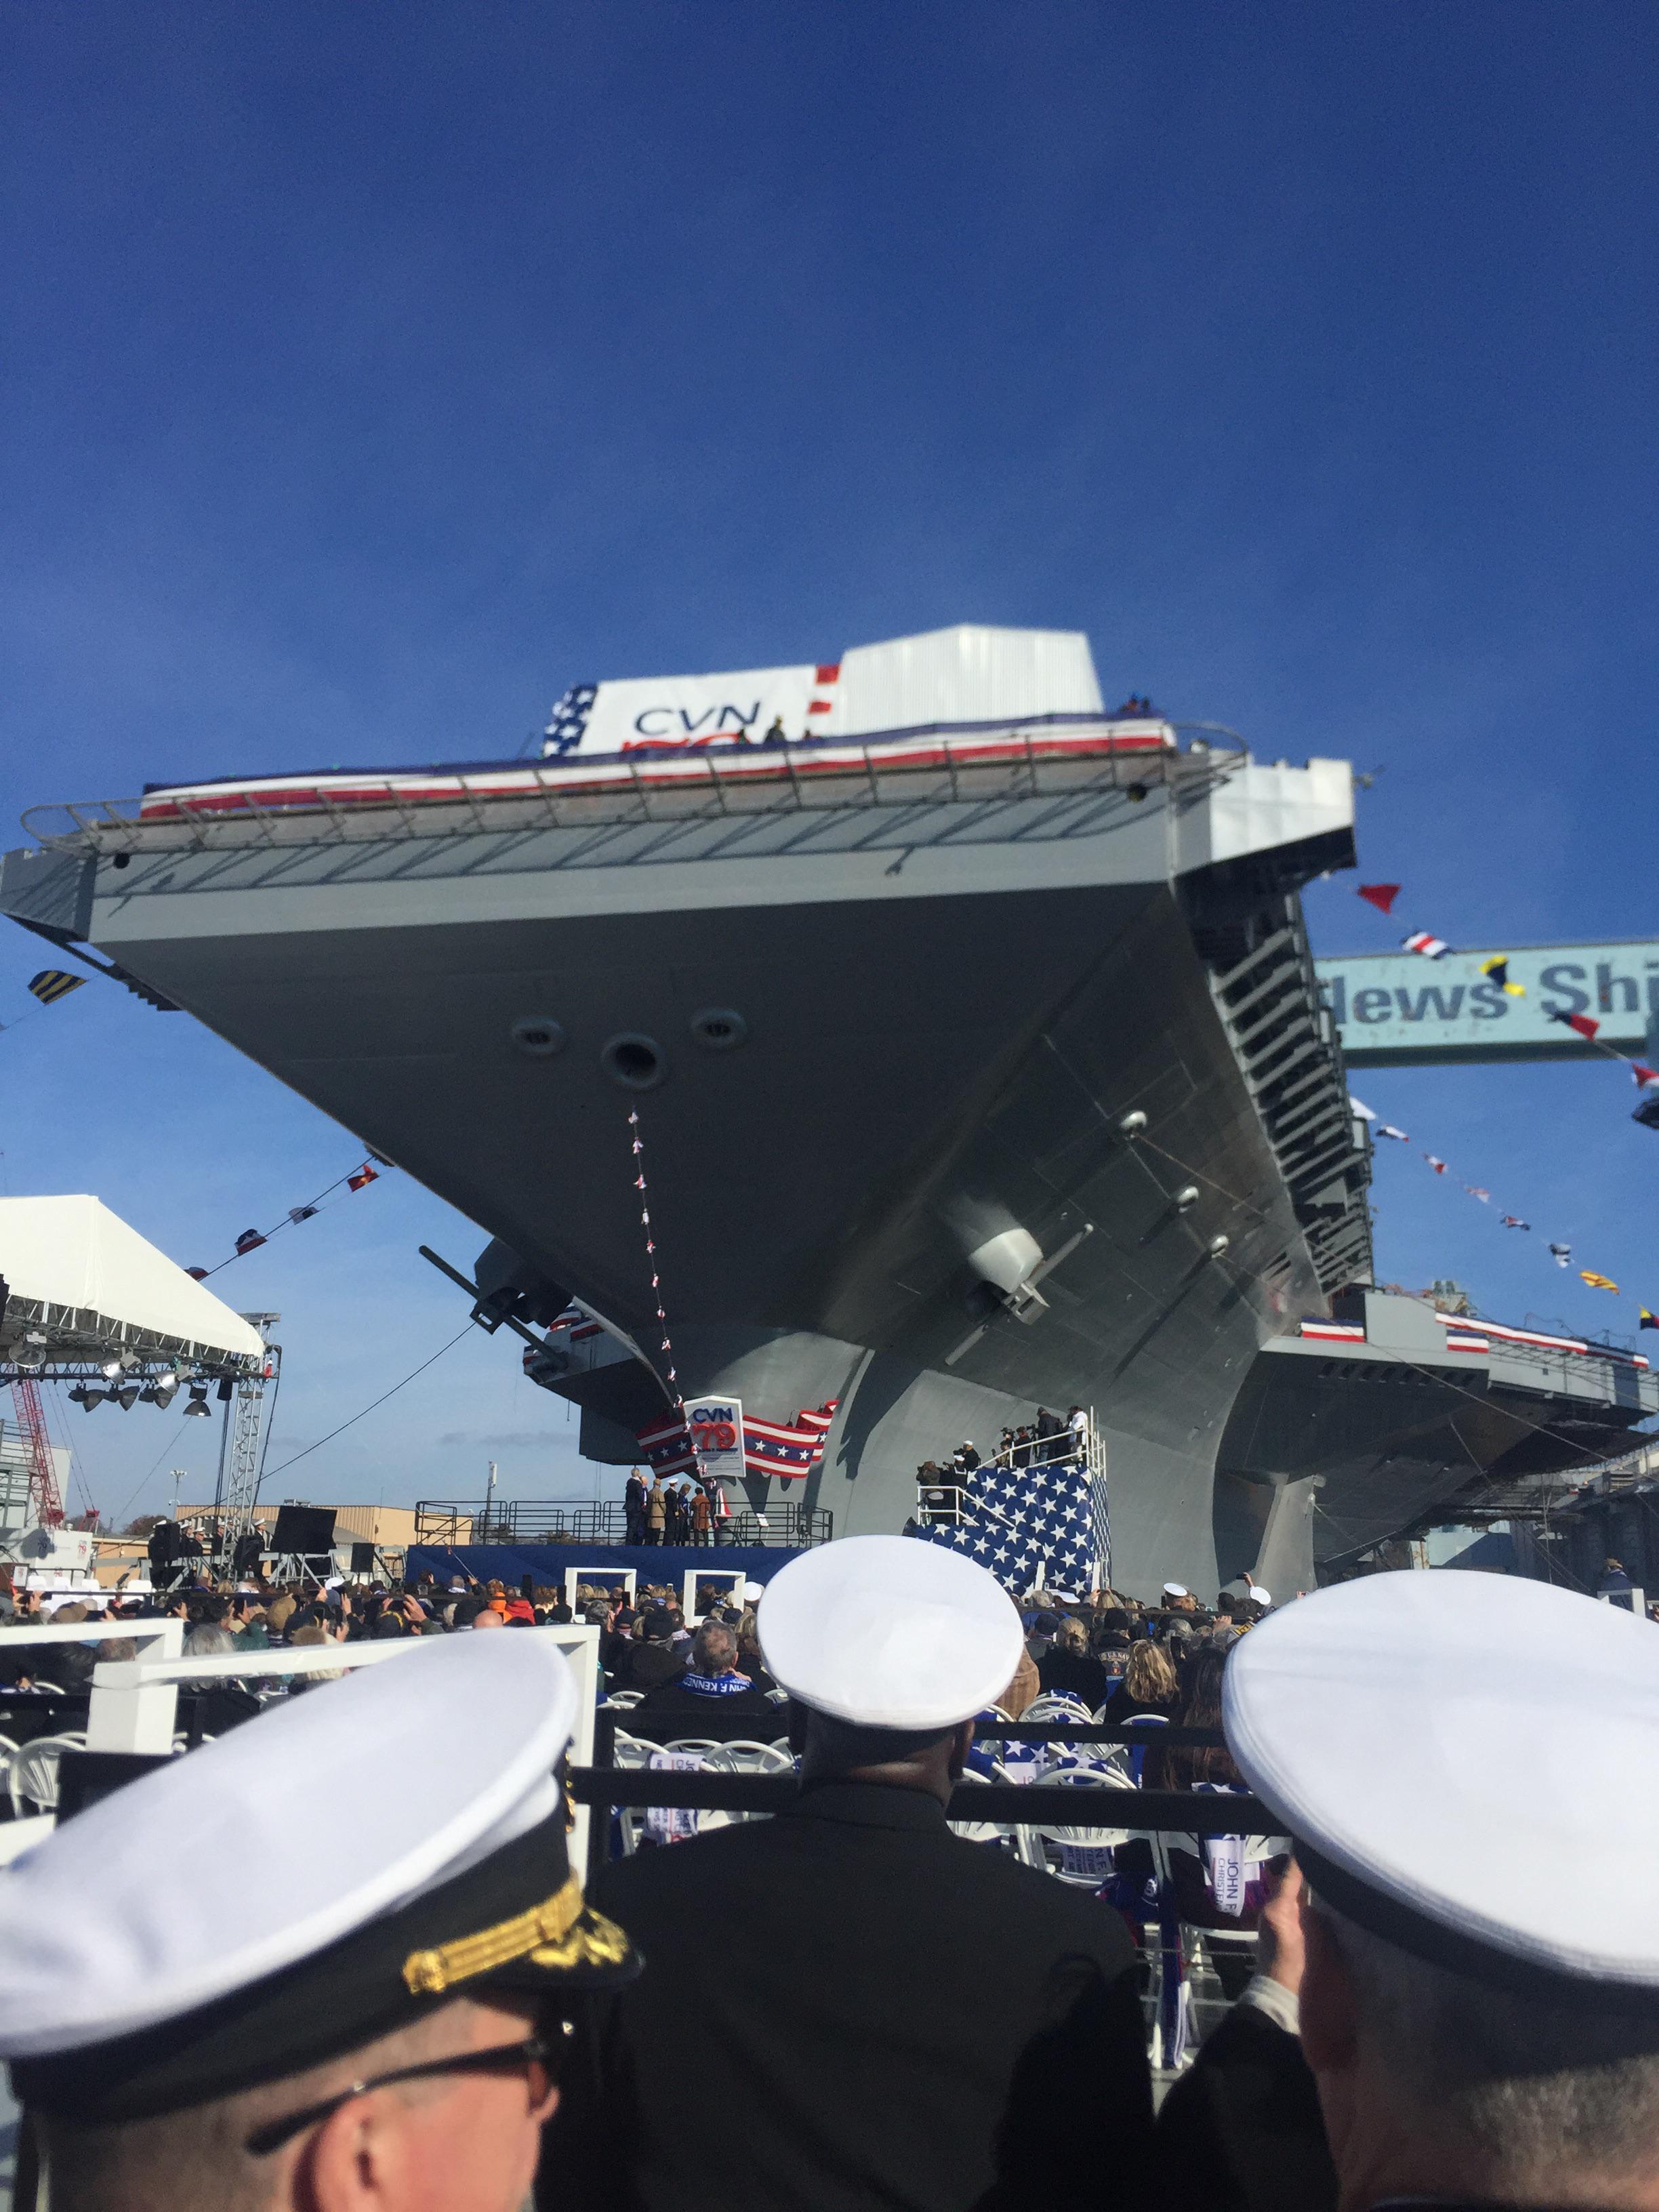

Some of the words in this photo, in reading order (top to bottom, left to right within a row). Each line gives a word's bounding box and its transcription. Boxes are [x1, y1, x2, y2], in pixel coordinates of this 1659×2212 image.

[634, 701, 760, 735] CVN
[693, 1407, 733, 1423] CVN
[693, 1422, 737, 1448] 79
[720, 1683, 727, 1692] F.
[1227, 1859, 1239, 1899] JOHN
